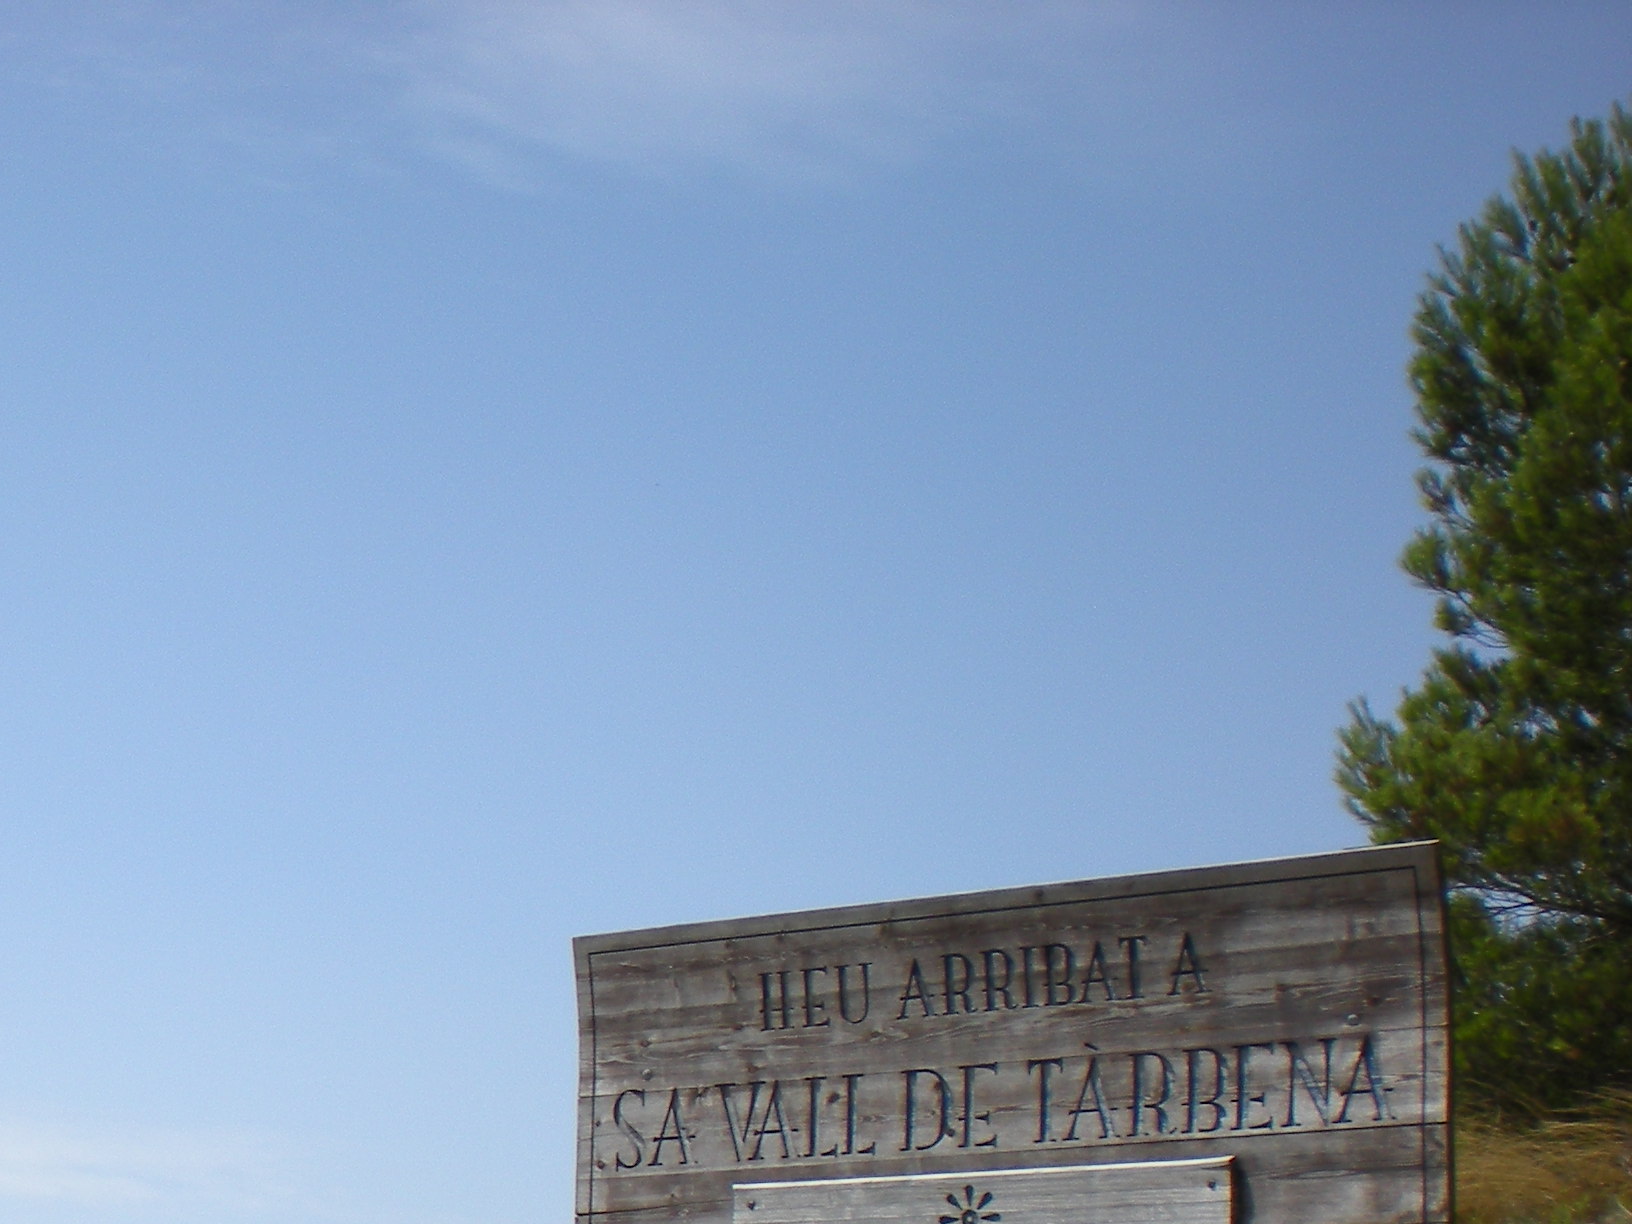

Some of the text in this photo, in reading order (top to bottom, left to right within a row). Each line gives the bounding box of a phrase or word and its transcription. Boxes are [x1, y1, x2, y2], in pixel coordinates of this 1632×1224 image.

[759, 932, 1214, 1031] HEU ARRIBAT A
[614, 1032, 1397, 1172] SA VALL DE TÀRBENA
